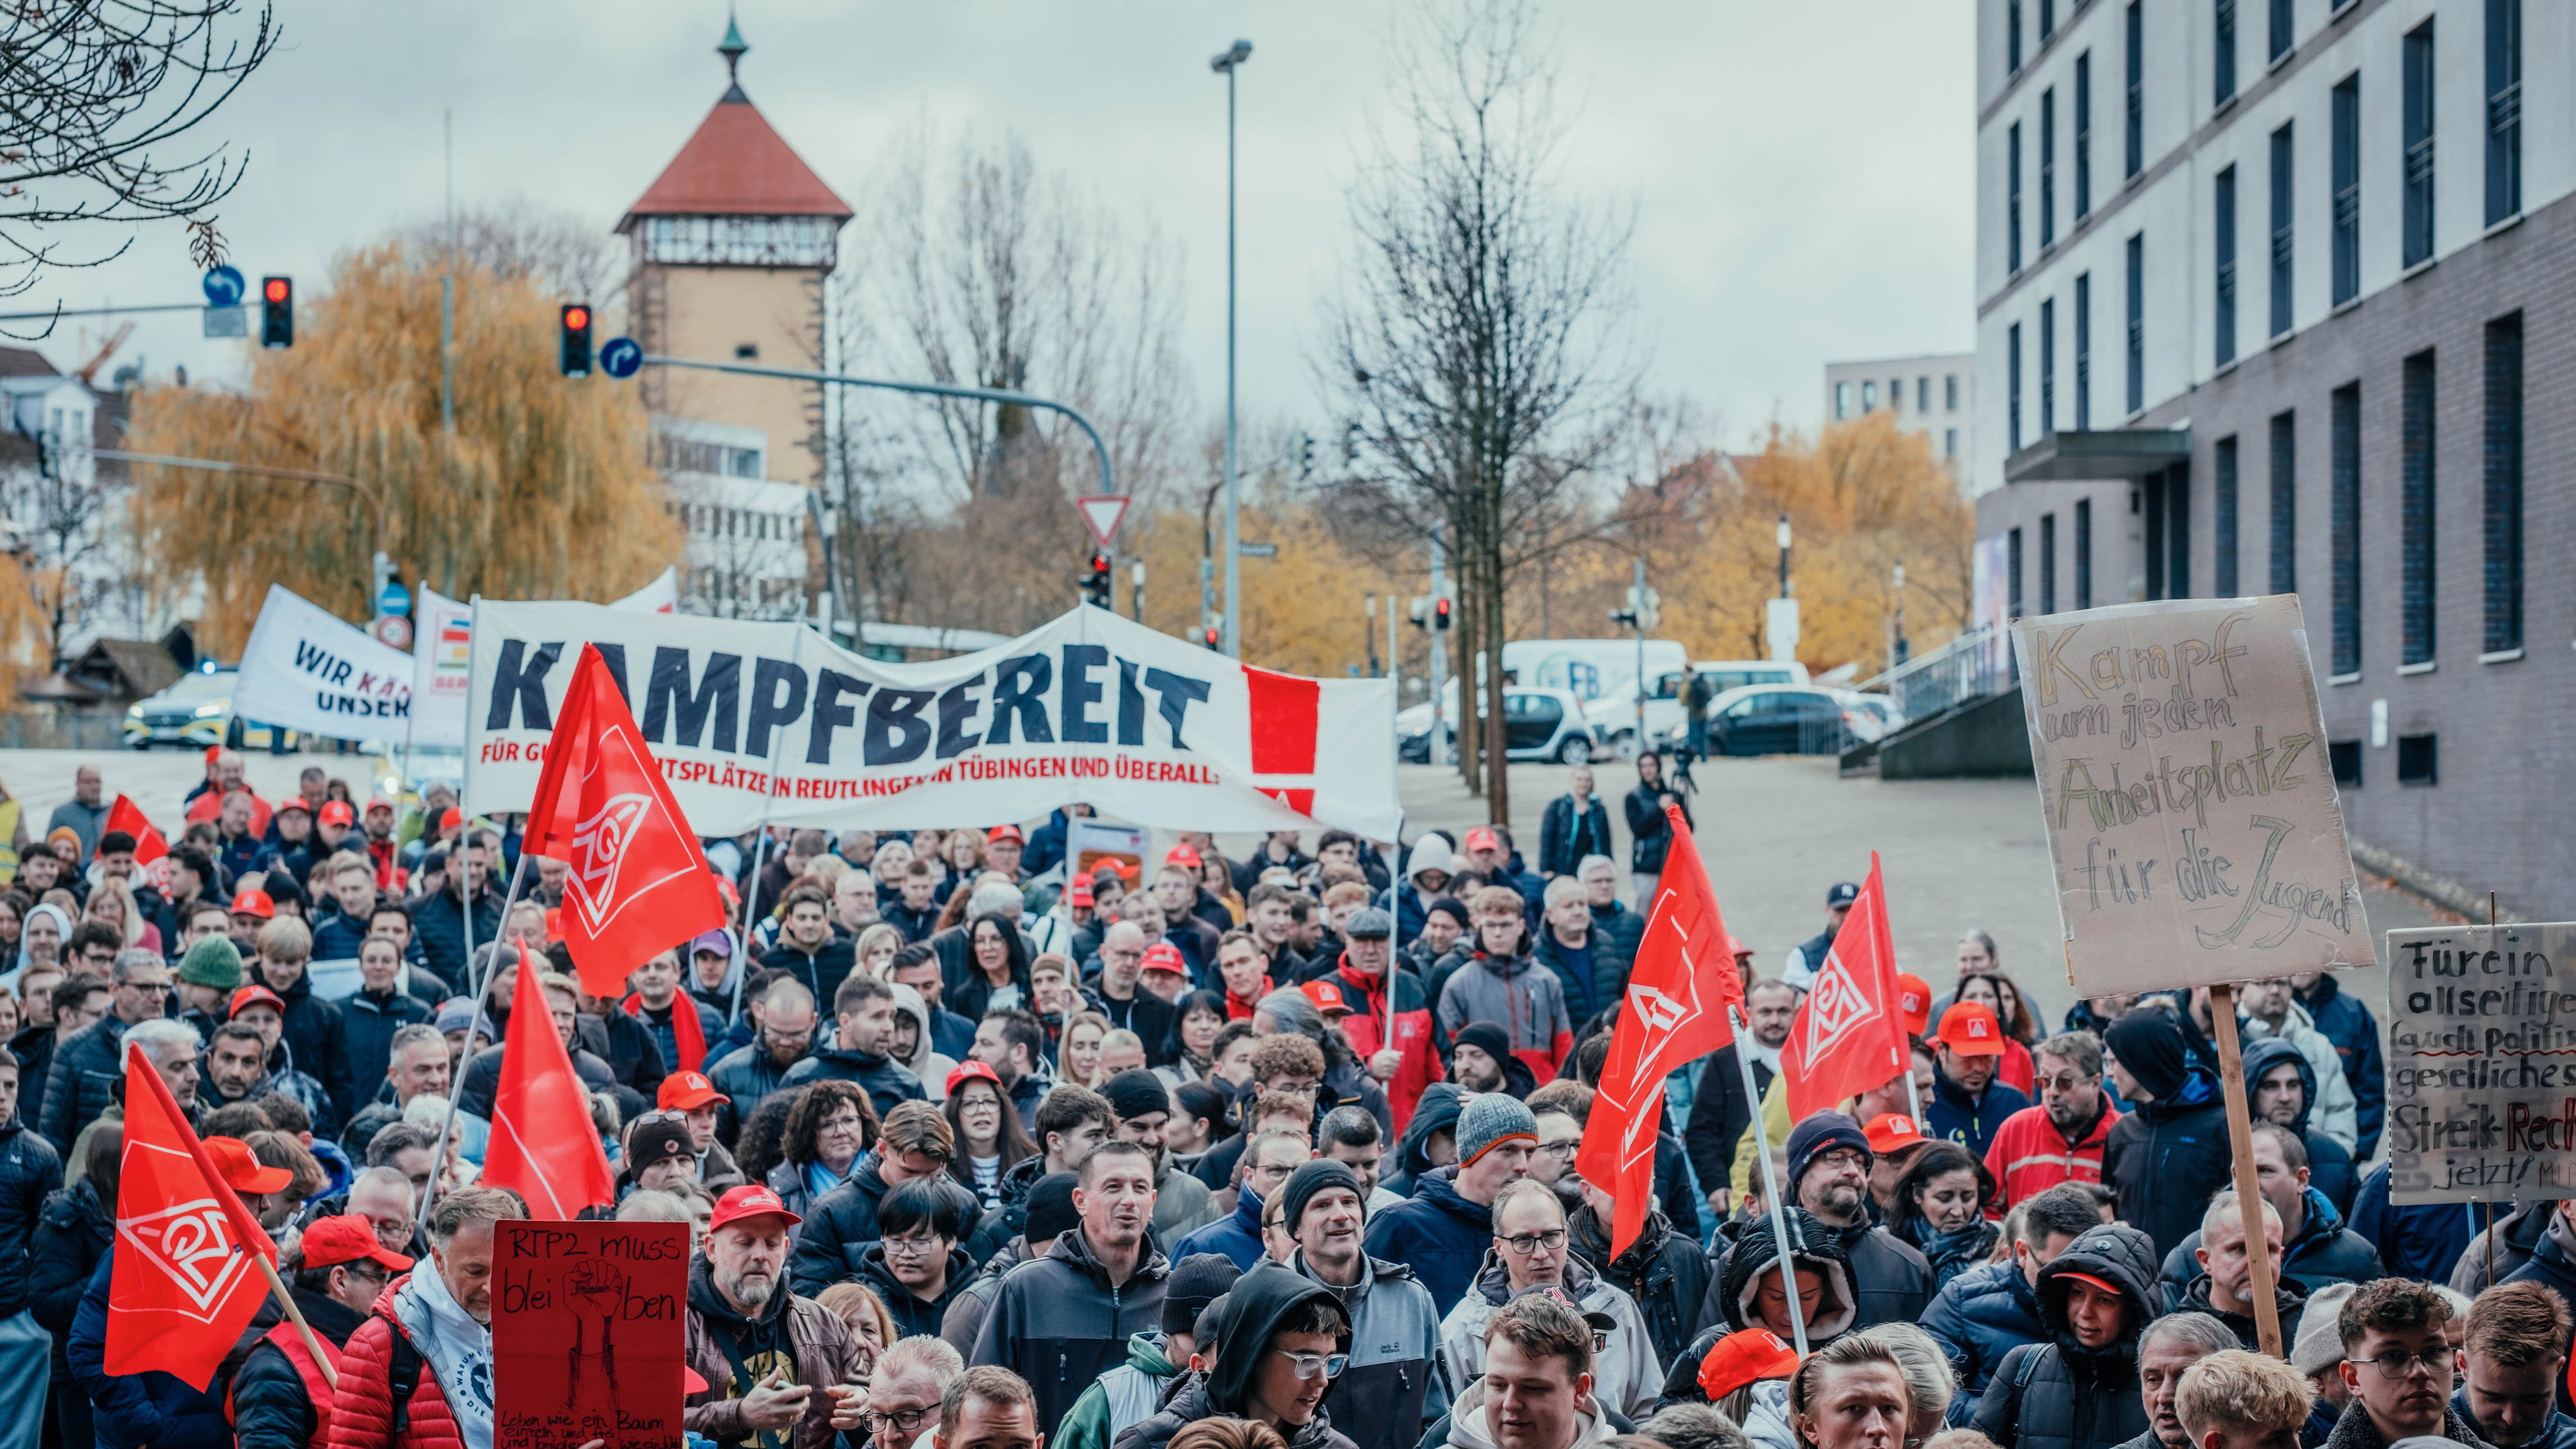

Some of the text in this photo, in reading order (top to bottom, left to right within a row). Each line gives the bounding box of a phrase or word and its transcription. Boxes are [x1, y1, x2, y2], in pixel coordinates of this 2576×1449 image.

[295, 640, 353, 686] WIR
[2038, 613, 2253, 706] Kampf
[2045, 686, 2236, 749] um jeden
[481, 737, 519, 763] FÜR
[771, 778, 791, 798] IN
[959, 755, 1066, 780] TÜBINGEN
[1071, 757, 1108, 778] UND
[2059, 727, 2315, 832] Arbeitsplatz
[2074, 815, 2350, 948] für die Jugend
[2433, 1155, 2535, 1190] jetzt!
[508, 1228, 680, 1260] RTP2 muss
[505, 1268, 675, 1320] blei ben
[467, 1400, 485, 1418] DIE
[501, 1409, 664, 1431] Leben wie ein Baum
[504, 1426, 556, 1438] einzeln
